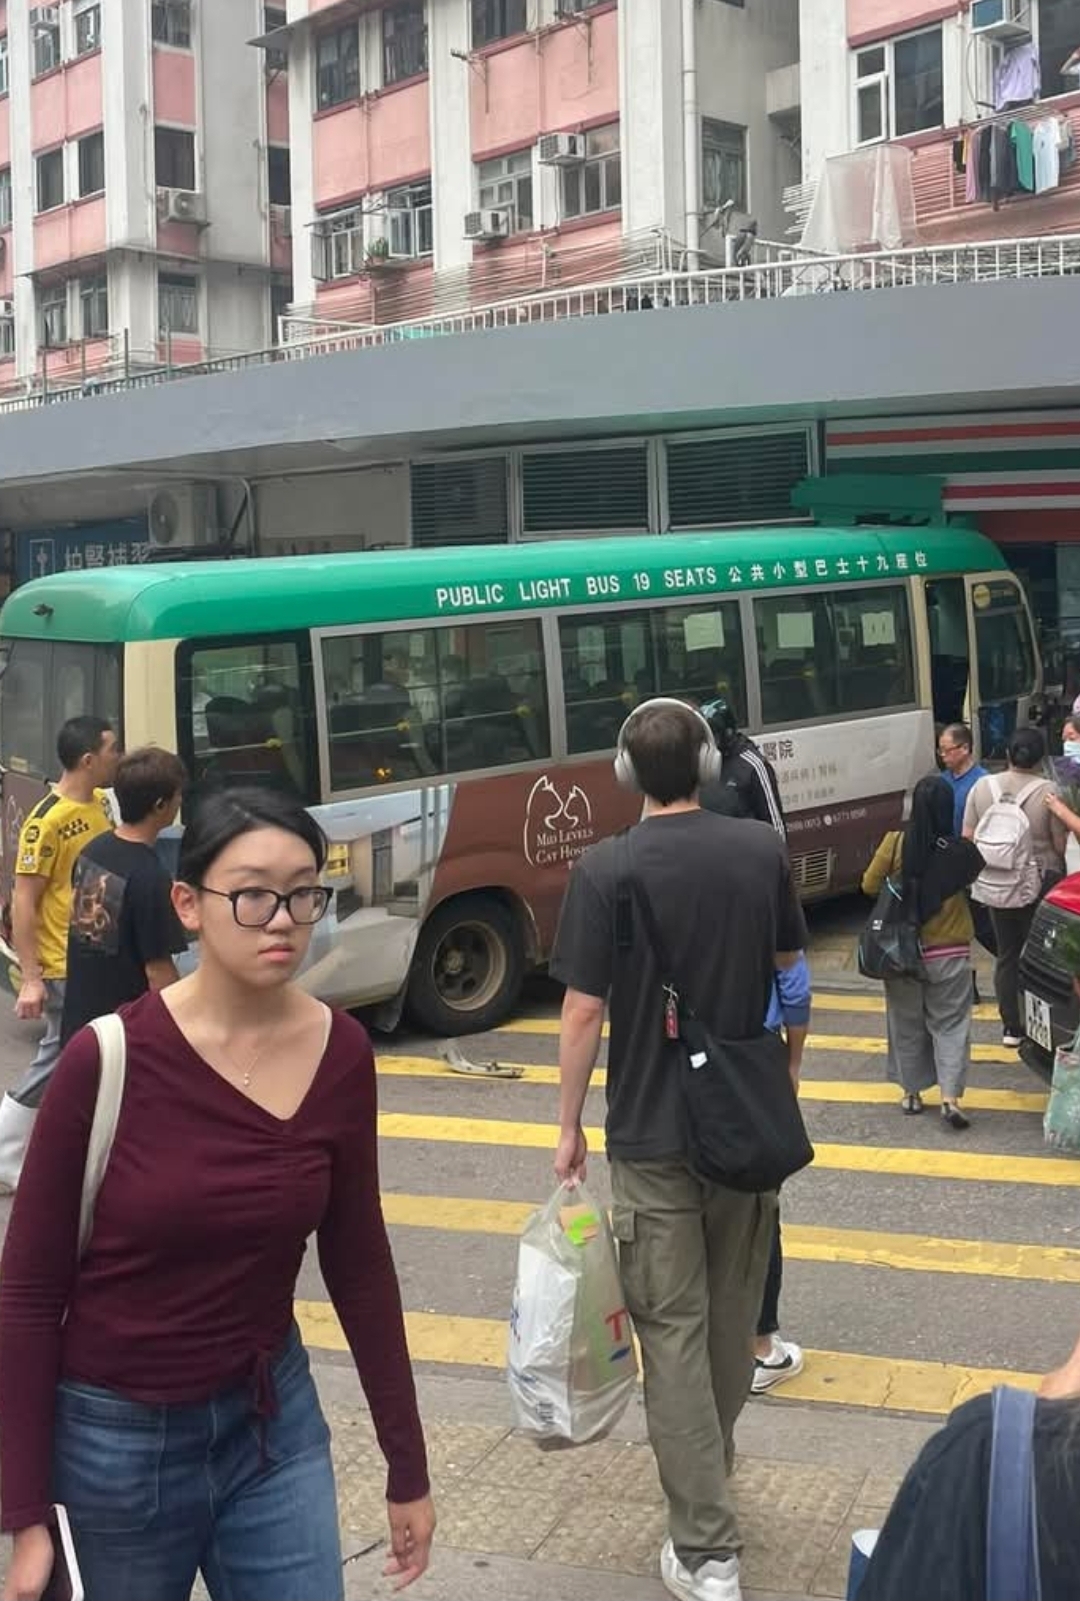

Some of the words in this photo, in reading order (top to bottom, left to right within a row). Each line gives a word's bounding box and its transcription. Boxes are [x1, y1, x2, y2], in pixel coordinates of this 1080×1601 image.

[436, 584, 504, 608] PUBLIC
[519, 578, 571, 601] LIGHT
[586, 575, 620, 596] BUS
[633, 572, 650, 591] 19
[664, 566, 717, 588] SEATS
